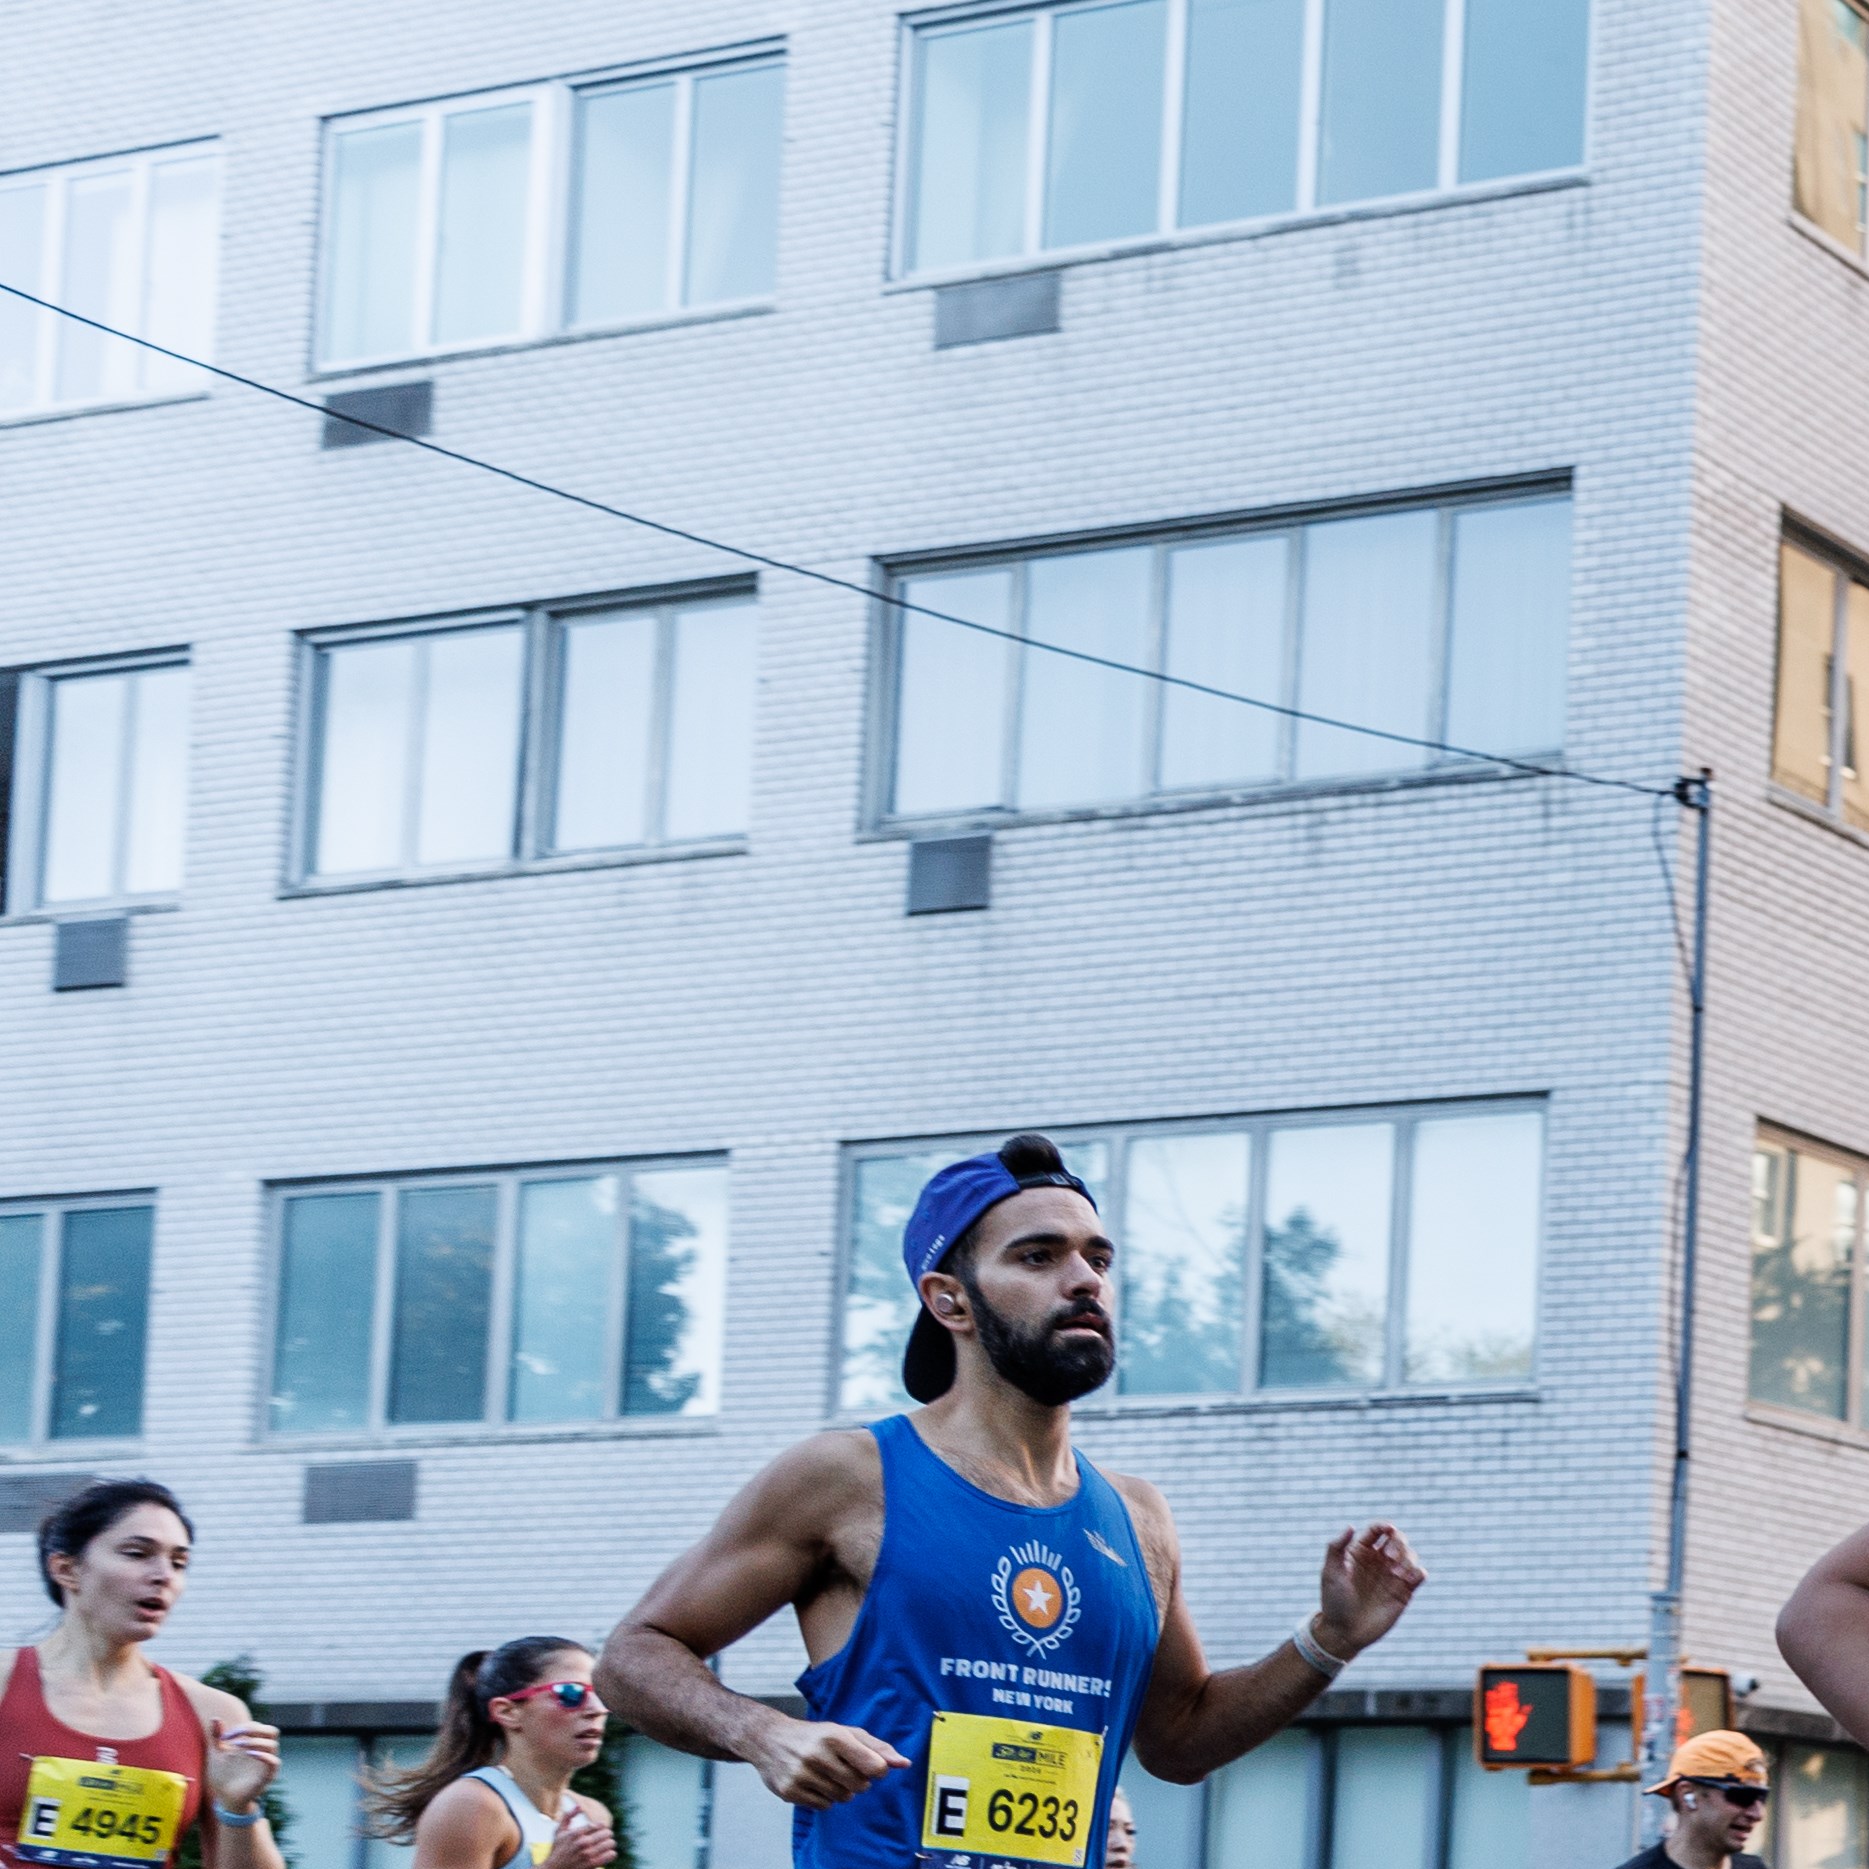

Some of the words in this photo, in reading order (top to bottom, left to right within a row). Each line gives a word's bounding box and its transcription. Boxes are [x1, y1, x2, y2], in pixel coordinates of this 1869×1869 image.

[940, 1657, 1019, 1682] FRONT
[992, 1688, 1031, 1707] NEW
[1033, 1694, 1074, 1715] YORK
[32, 1803, 60, 1838] E
[70, 1807, 162, 1845] 4945
[936, 1788, 968, 1837] E
[987, 1788, 1079, 1842] 6233
